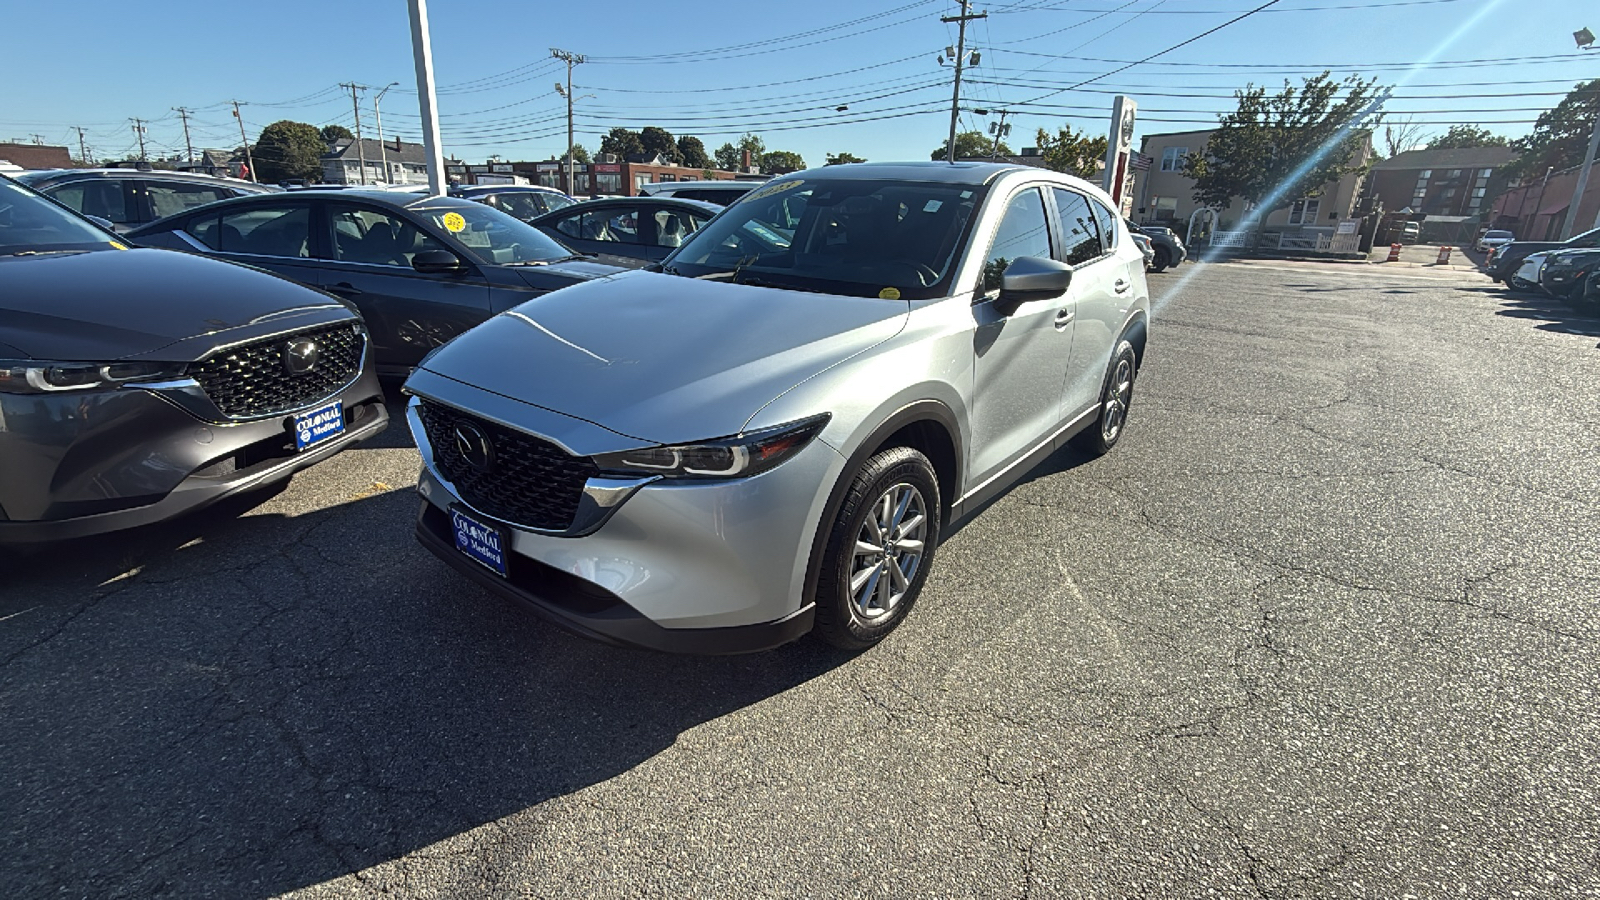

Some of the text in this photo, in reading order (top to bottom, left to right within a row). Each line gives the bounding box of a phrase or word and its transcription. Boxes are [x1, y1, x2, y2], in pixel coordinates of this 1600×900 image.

[296, 408, 341, 432] COLONIAL
[312, 418, 341, 436] Medford
[453, 512, 501, 552] COLONIAL
[470, 539, 501, 564] Medford
